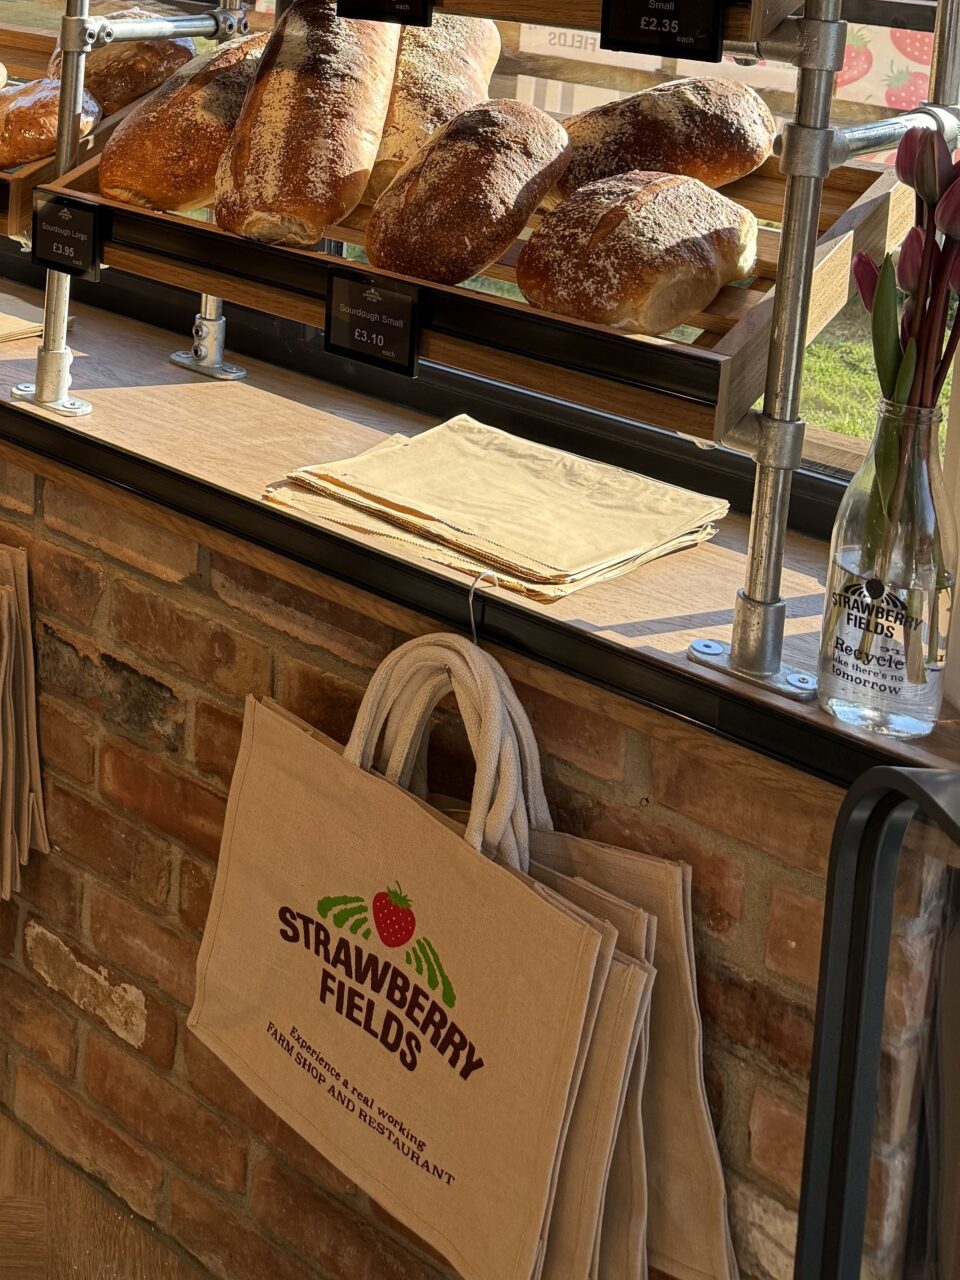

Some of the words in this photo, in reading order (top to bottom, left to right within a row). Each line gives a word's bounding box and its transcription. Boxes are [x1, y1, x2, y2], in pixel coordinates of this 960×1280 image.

[395, 3, 410, 11] each
[648, 0, 675, 10] Small
[640, 16, 679, 33] £2.35
[676, 35, 694, 44] each
[42, 222, 71, 236] Sourdough
[53, 242, 74, 257] £3.95
[340, 303, 380, 322] Sourdough
[381, 314, 403, 328] Small
[354, 328, 384, 346] £3.10
[382, 349, 395, 358] each
[832, 592, 923, 631] STRAWBERRY
[846, 612, 896, 639] FIELDS
[835, 636, 905, 671] Recycle
[832, 664, 902, 695] tomorrow
[852, 663, 888, 680] there's
[890, 673, 904, 682] no
[278, 905, 485, 1082] STRAWBERRY
[319, 967, 422, 1073] FIELDS
[289, 1025, 342, 1082] Experience
[342, 1078, 349, 1089] a
[351, 1086, 375, 1110] real
[377, 1106, 427, 1153] working
[265, 1021, 296, 1057] FARM
[294, 1051, 327, 1086] SHOP
[327, 1084, 356, 1113] AND
[358, 1108, 456, 1187] RESTAURANT
